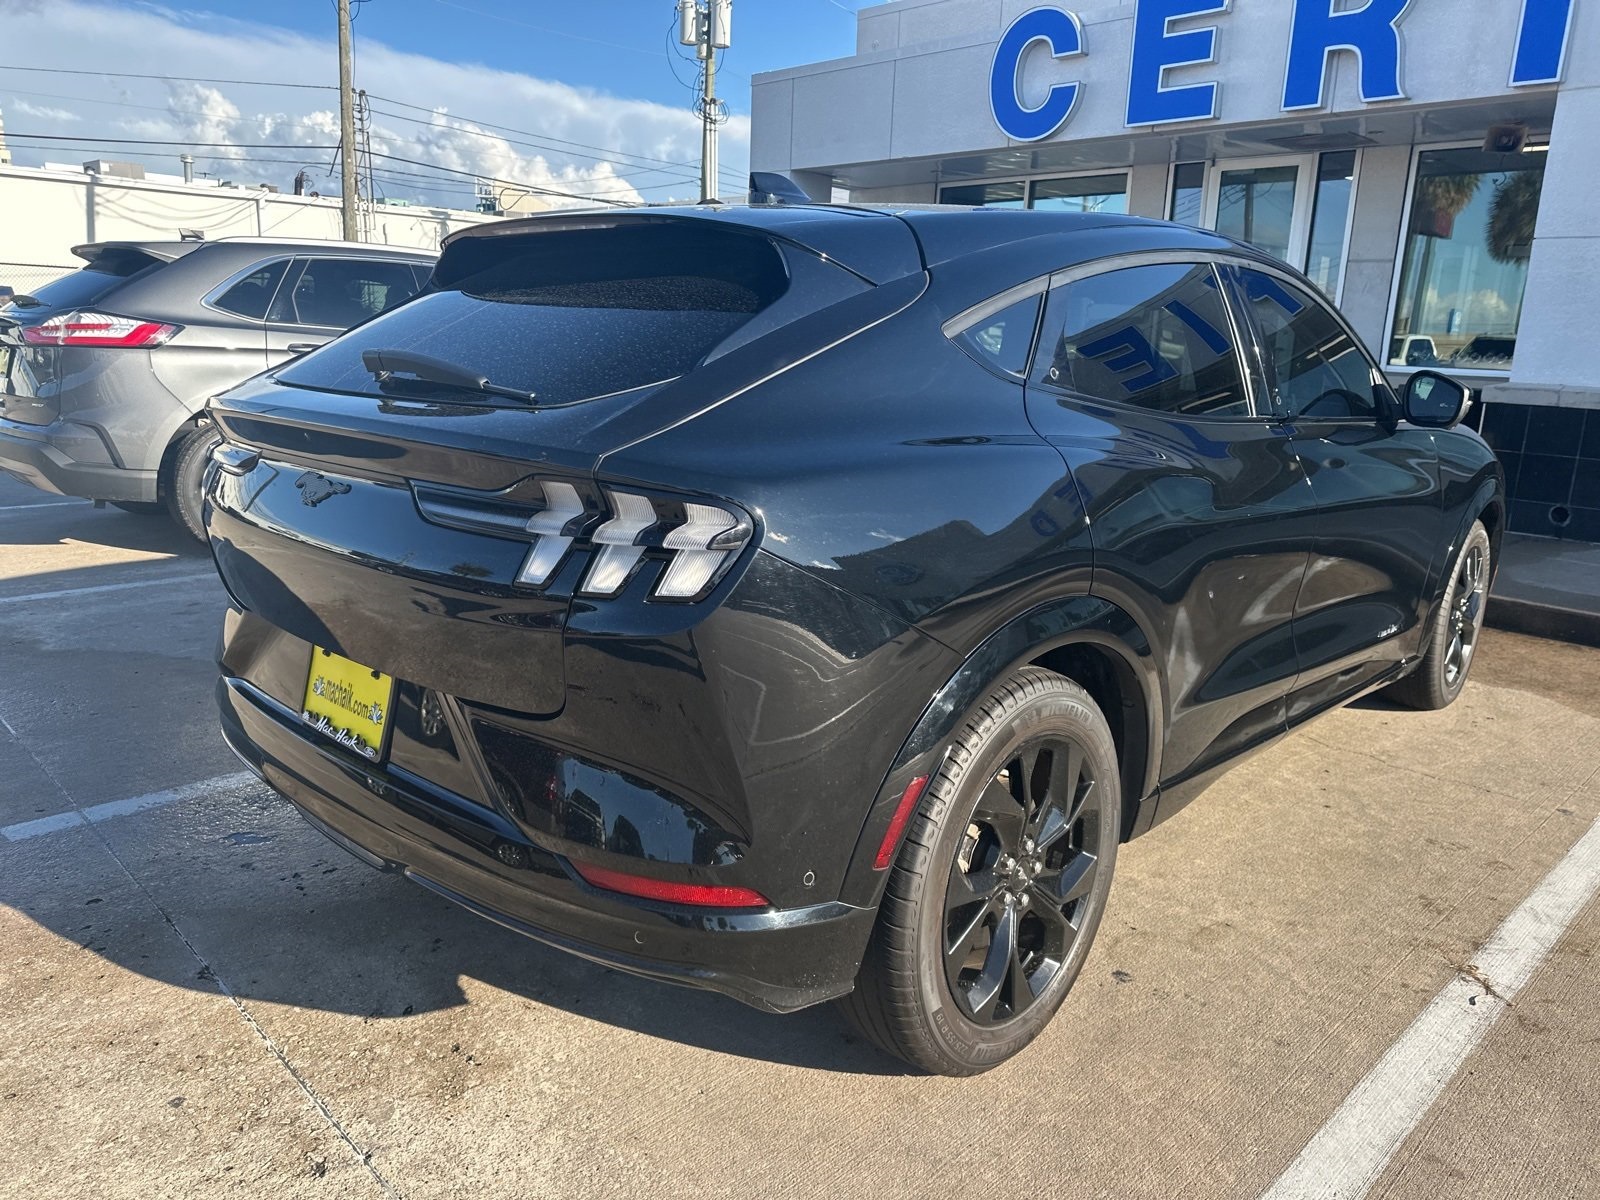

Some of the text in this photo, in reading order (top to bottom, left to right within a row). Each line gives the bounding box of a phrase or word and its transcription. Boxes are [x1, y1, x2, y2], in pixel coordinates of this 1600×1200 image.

[325, 680, 369, 719] machaik.com
[315, 716, 359, 748] Mac Haik
[935, 1013, 968, 1055] 225/55 R 19
